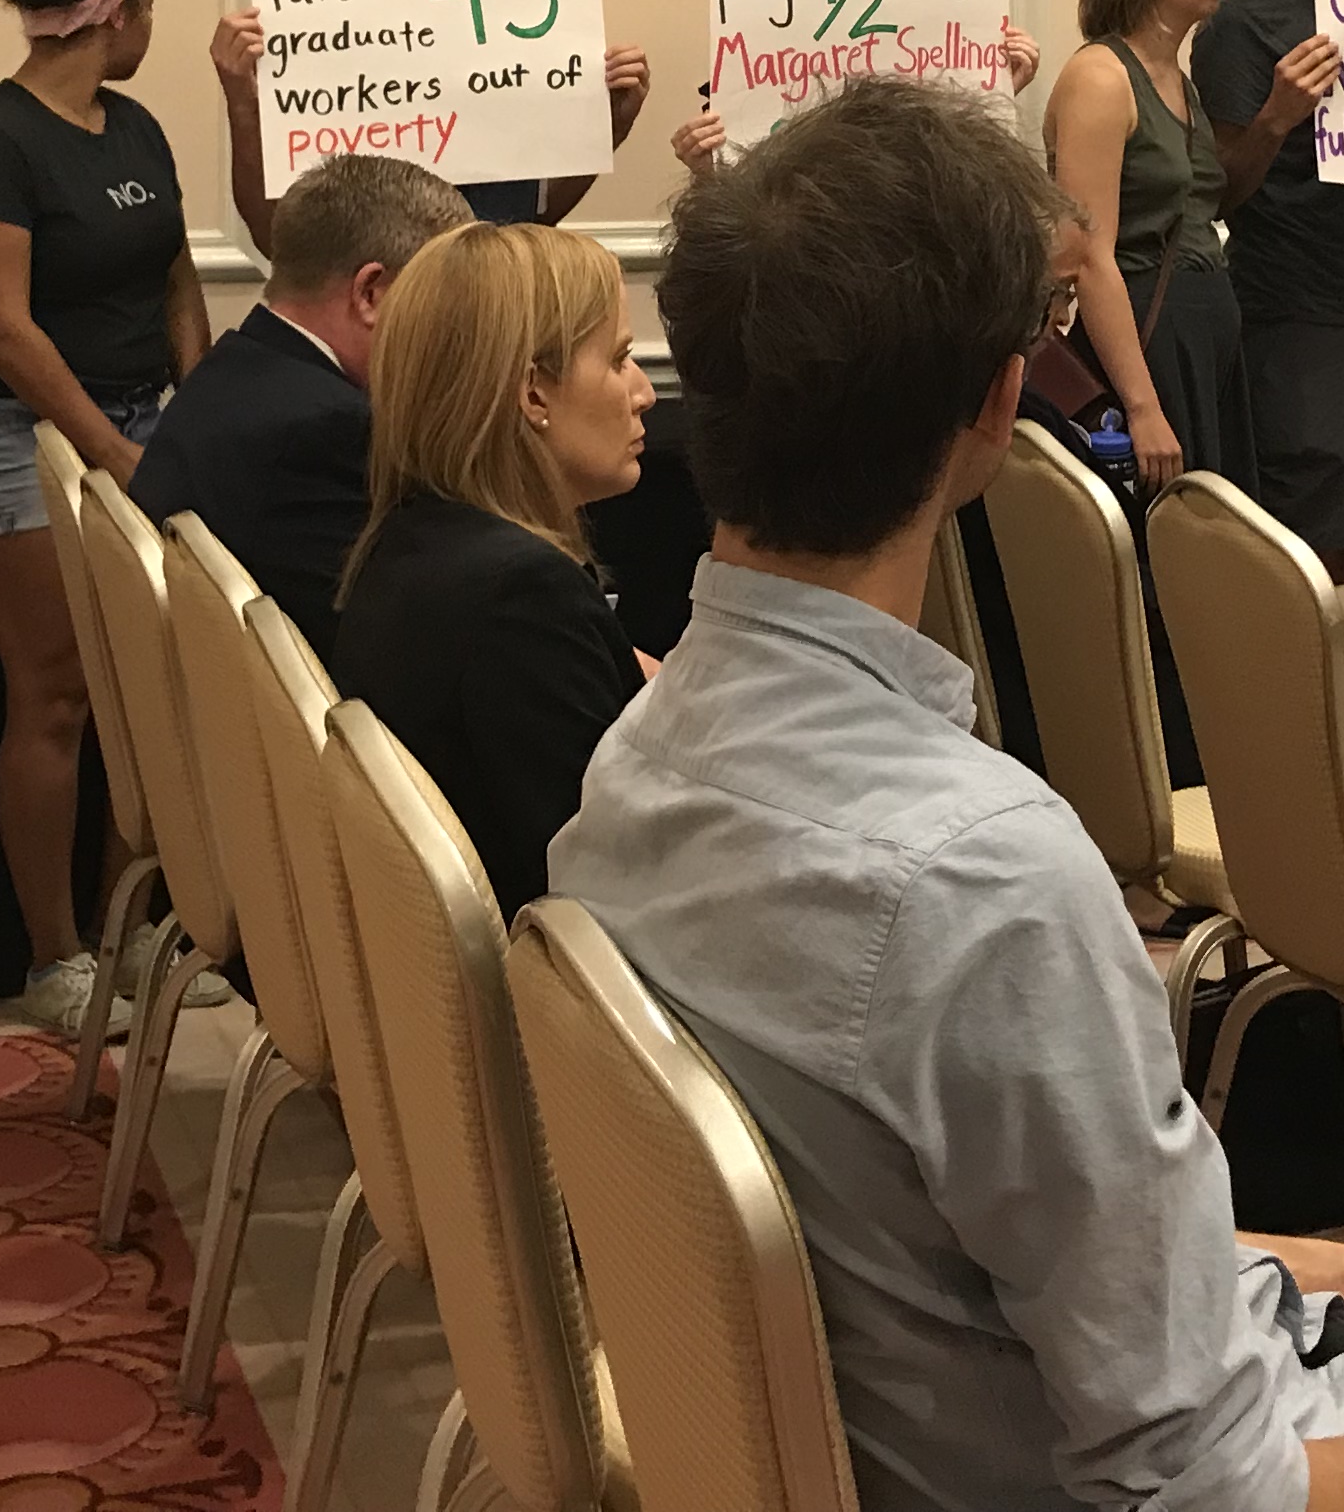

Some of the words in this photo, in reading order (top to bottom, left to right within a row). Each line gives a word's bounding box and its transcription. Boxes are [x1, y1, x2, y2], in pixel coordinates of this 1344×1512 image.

[267, 21, 435, 78] graduate
[711, 31, 880, 103] Margaret
[274, 74, 441, 116] workers
[469, 63, 530, 94] out
[547, 55, 582, 89] of
[289, 111, 457, 172] poverty
[107, 181, 156, 209] NO.
